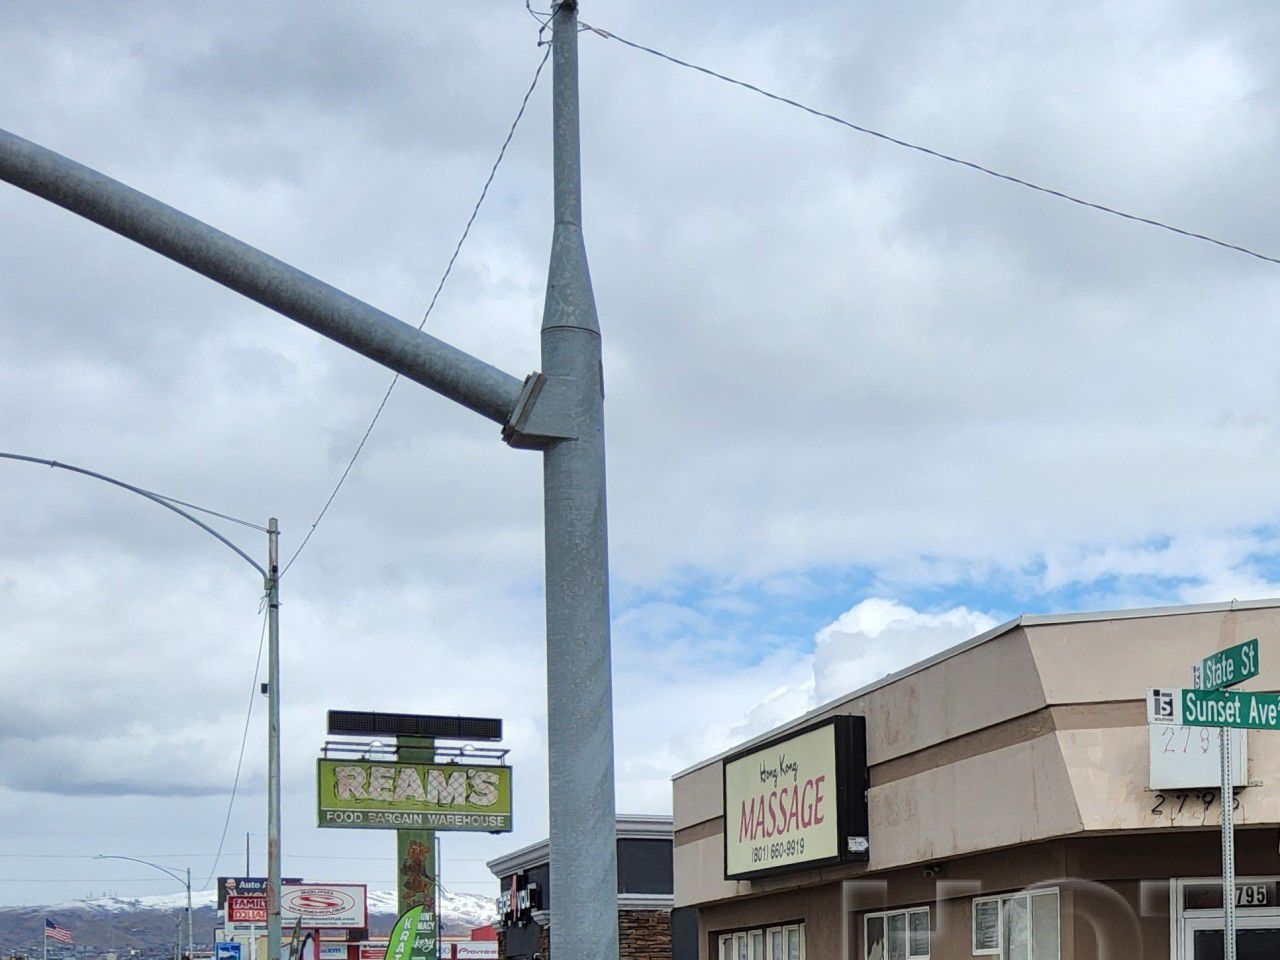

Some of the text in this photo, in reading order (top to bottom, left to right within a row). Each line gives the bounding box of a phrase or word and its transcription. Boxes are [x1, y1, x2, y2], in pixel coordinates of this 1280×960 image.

[1205, 643, 1255, 689] State St
[1185, 692, 1241, 724] Sunset
[1248, 695, 1278, 725] Ave
[1162, 727, 1222, 754] 279
[760, 753, 799, 788] Hong Kong
[334, 765, 500, 806] REAM'S
[326, 811, 505, 827] FOOD BARGAIN WAREHOUSE
[738, 775, 826, 843] MASSAGE
[751, 837, 805, 863] (801) 660-9919
[239, 880, 260, 889] Auto
[1236, 886, 1266, 905] 795
[413, 935, 435, 953] kery
[459, 947, 497, 955] Pionee
